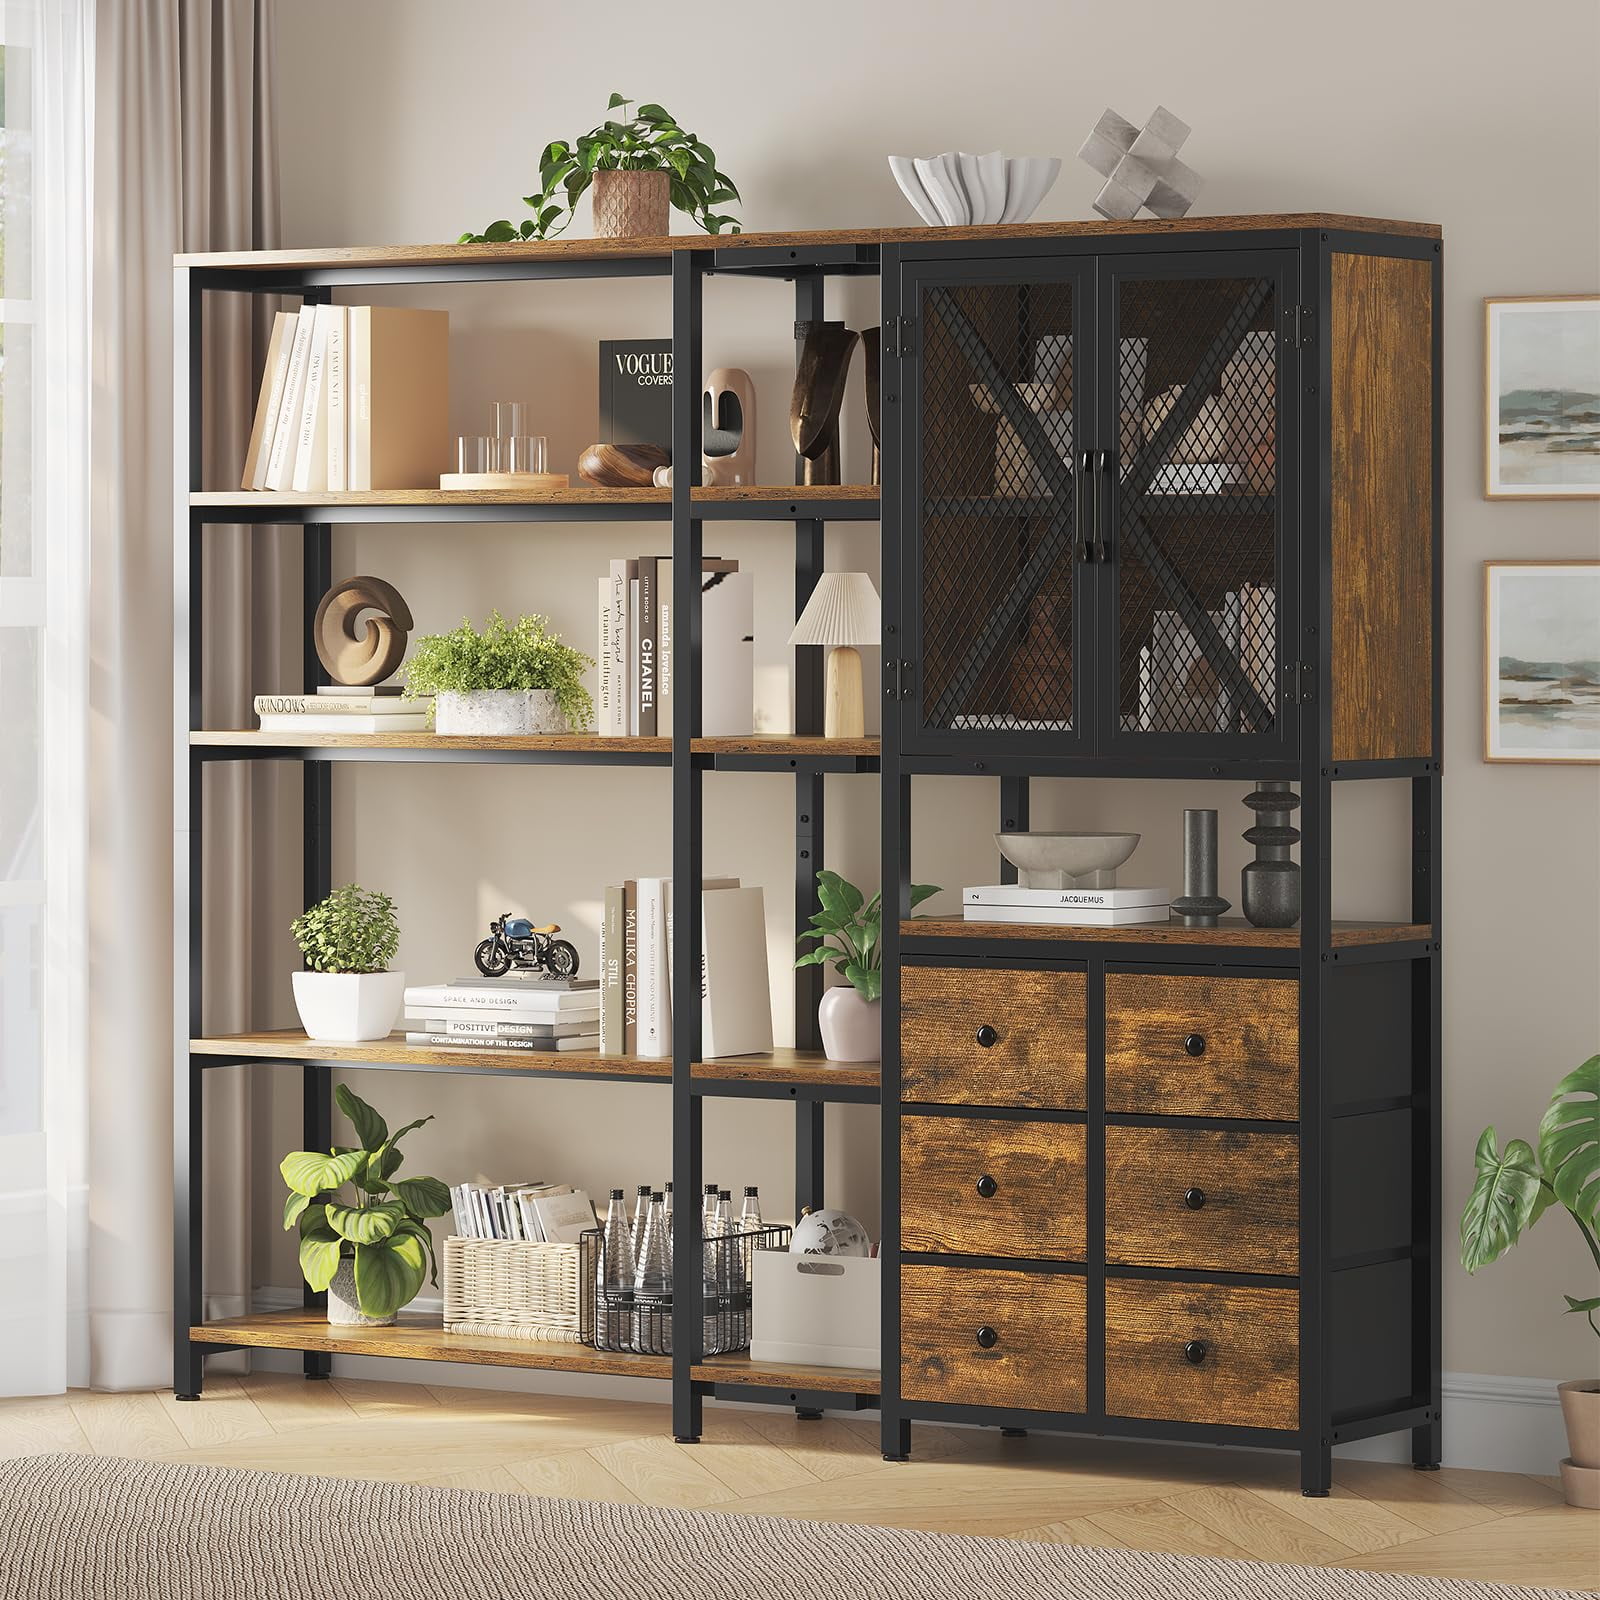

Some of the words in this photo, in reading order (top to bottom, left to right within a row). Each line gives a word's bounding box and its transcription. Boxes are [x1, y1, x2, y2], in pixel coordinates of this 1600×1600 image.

[288, 362, 300, 405] sustainable
[296, 328, 306, 362] lifestyle
[616, 353, 673, 375] VOGUE
[638, 375, 673, 386] COVERS
[662, 604, 670, 647] amanda
[642, 638, 652, 712] CHANEL
[258, 698, 306, 713] WINDOWS
[1060, 895, 1104, 904] JACQUEMUS
[626, 910, 636, 967] MALLIKA
[608, 959, 618, 988] STILL
[489, 998, 518, 1006] DESIGN
[626, 974, 636, 1025] CHOPRA
[453, 1023, 496, 1032] POSITIVE
[498, 1025, 532, 1034] DESIGN
[431, 1036, 484, 1046] CONTAMINATION
[495, 1039, 508, 1047] THE
[509, 1040, 533, 1048] DESIGN
